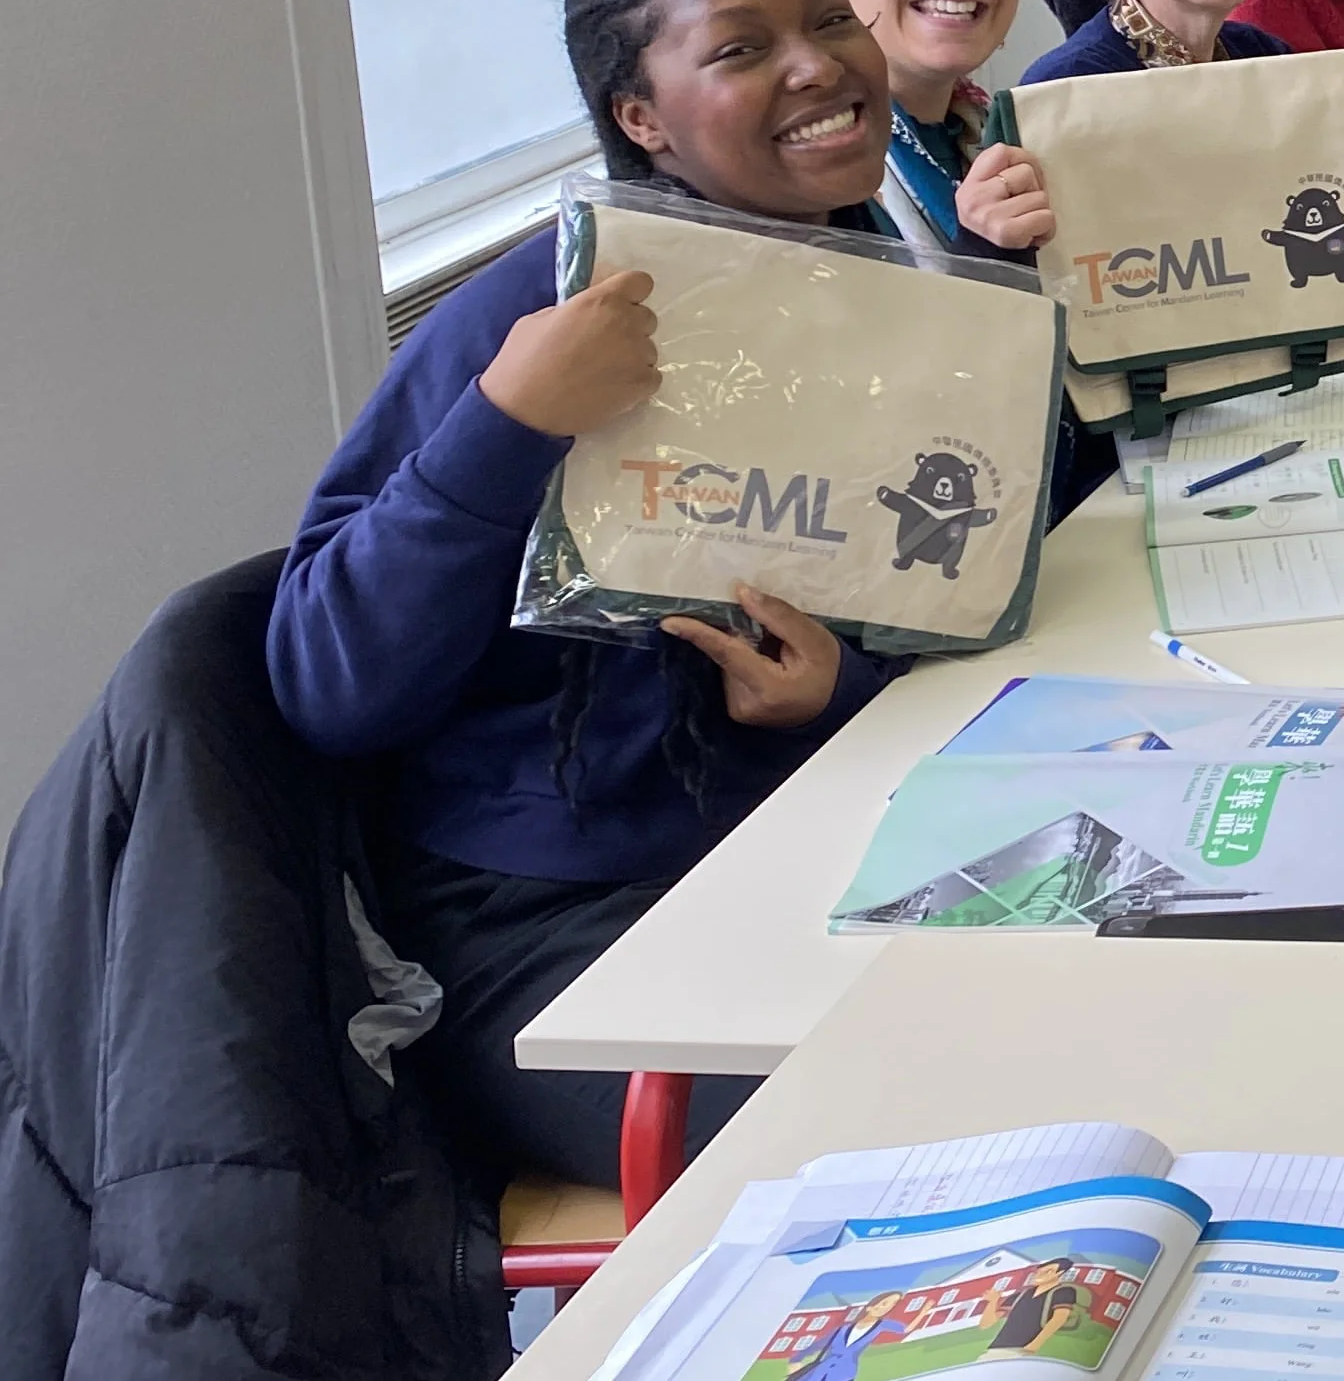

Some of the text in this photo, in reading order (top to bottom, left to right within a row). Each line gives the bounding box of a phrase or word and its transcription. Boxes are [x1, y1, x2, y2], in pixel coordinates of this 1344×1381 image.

[1073, 237, 1250, 304] TCML
[621, 459, 848, 544] TCML
[1185, 802, 1214, 847] Mandarin
[1251, 1265, 1321, 1281] Vocabulary
